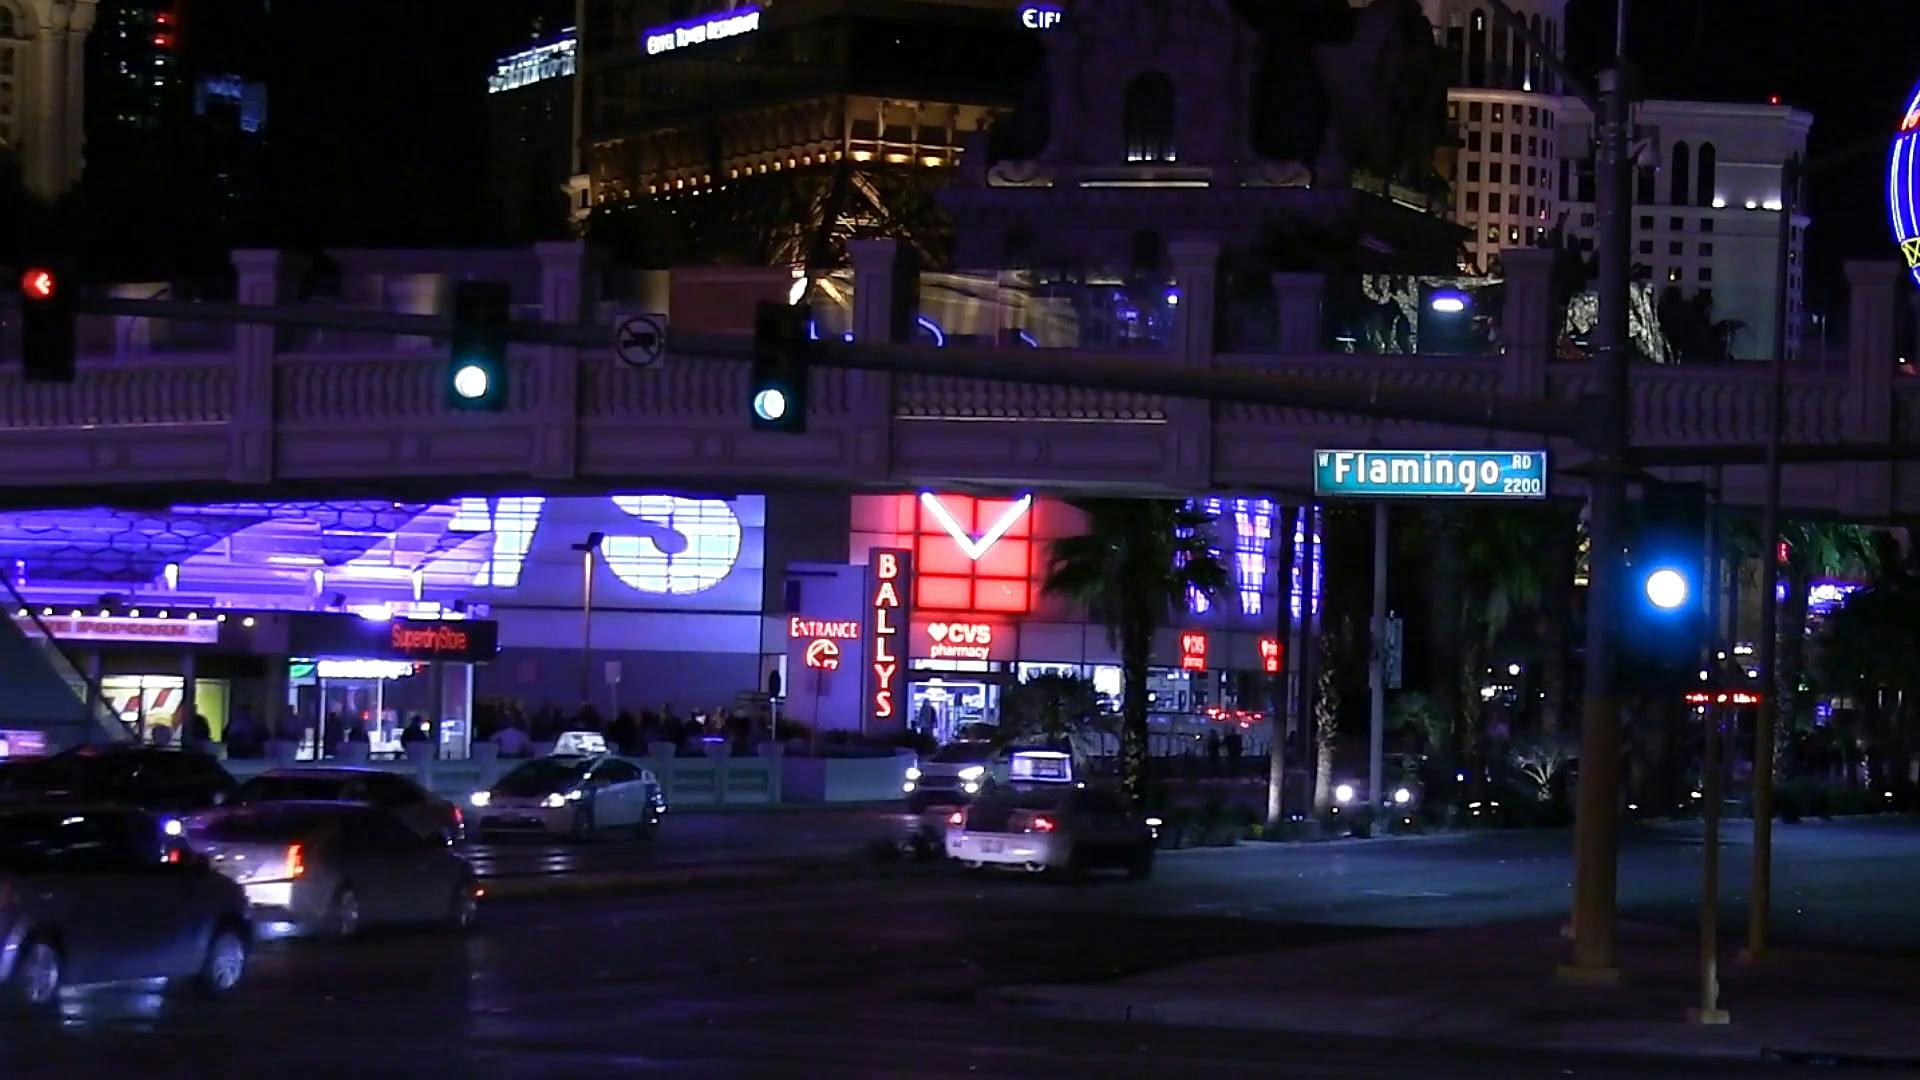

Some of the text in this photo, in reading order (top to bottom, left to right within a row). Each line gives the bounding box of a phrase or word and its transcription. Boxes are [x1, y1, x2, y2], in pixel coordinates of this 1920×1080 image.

[1318, 452, 1532, 493] W Flamingo RD
[1503, 478, 1541, 493] 2200
[791, 617, 858, 638] ENTRANCE
[948, 624, 992, 644] CVS
[930, 645, 990, 659] pharmacy
